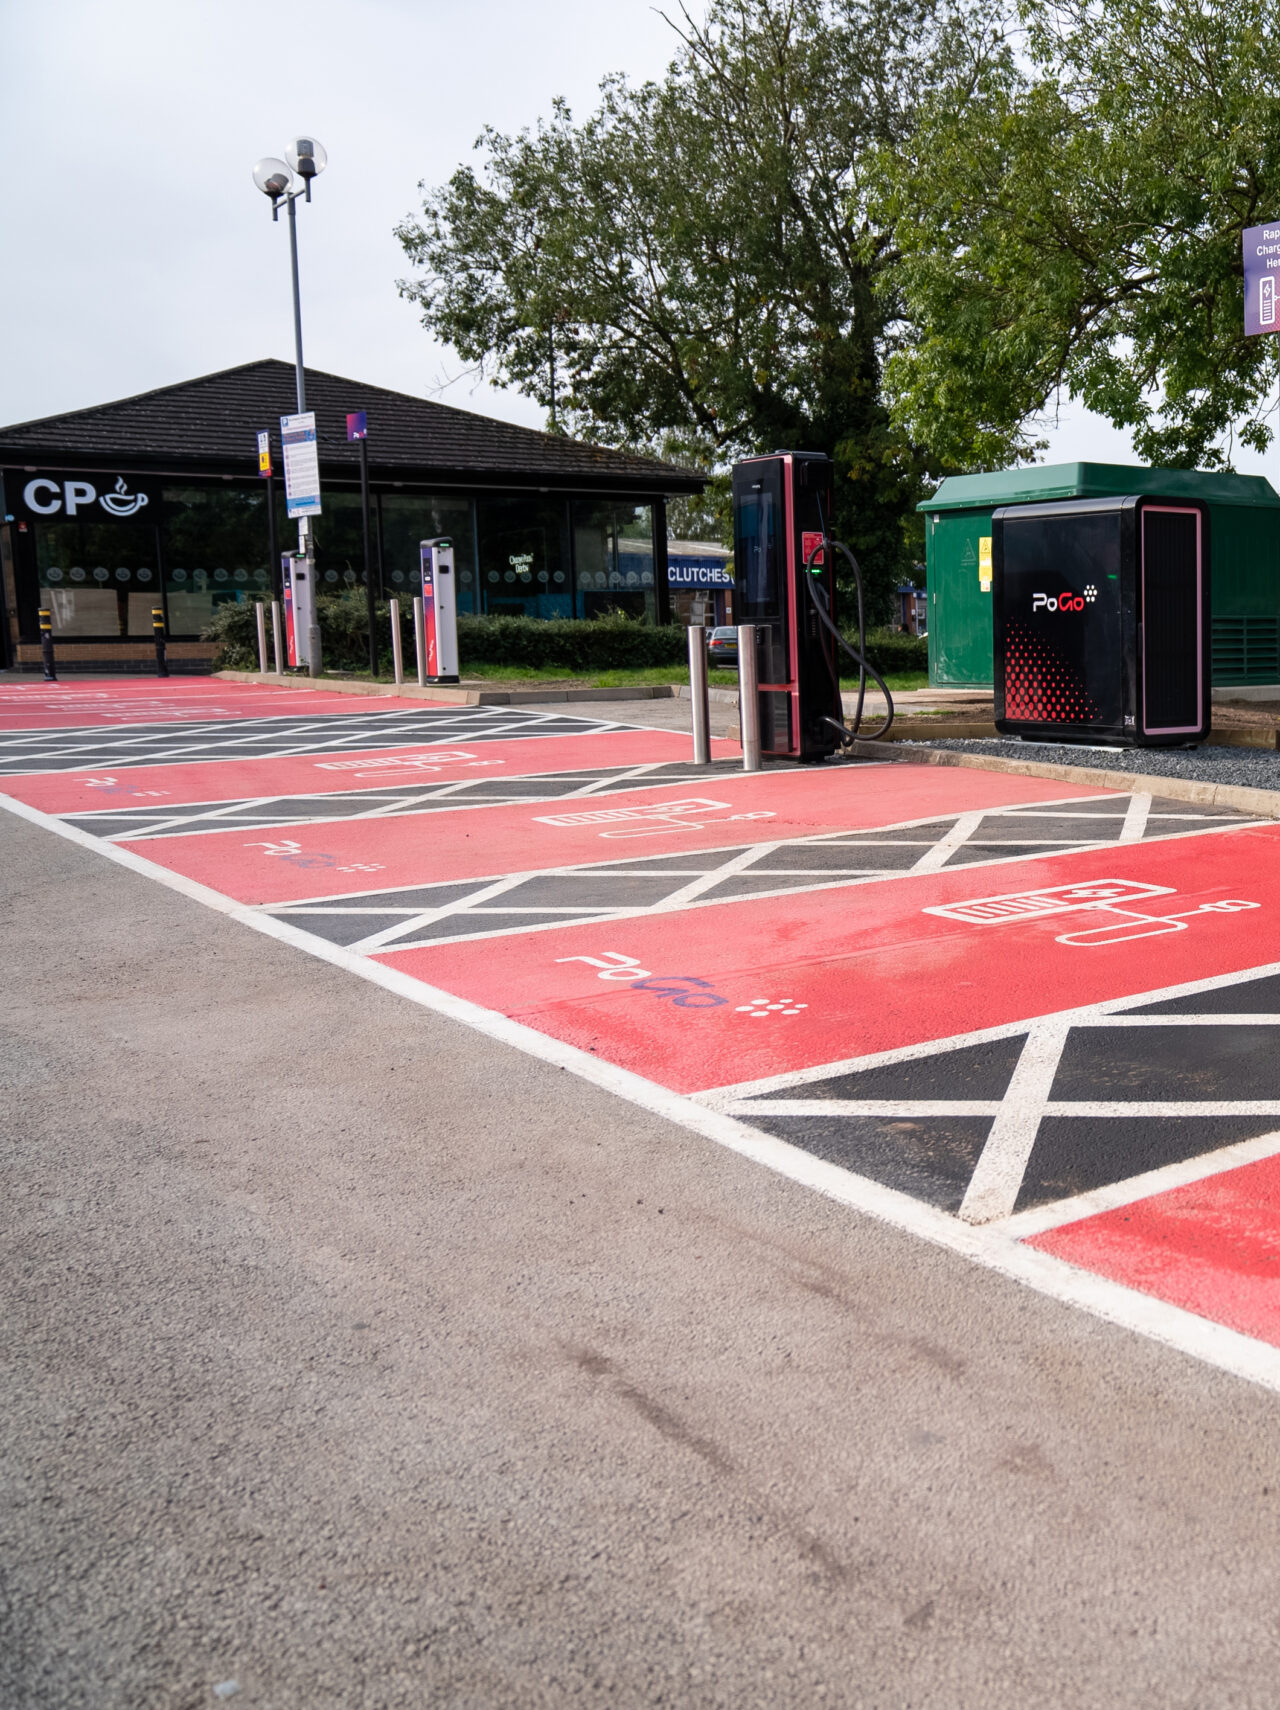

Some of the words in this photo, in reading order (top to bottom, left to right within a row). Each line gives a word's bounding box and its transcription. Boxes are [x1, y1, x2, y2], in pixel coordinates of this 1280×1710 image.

[23, 478, 97, 516] CP
[668, 566, 730, 582] CLUTCHES
[1032, 592, 1085, 612] PoGo
